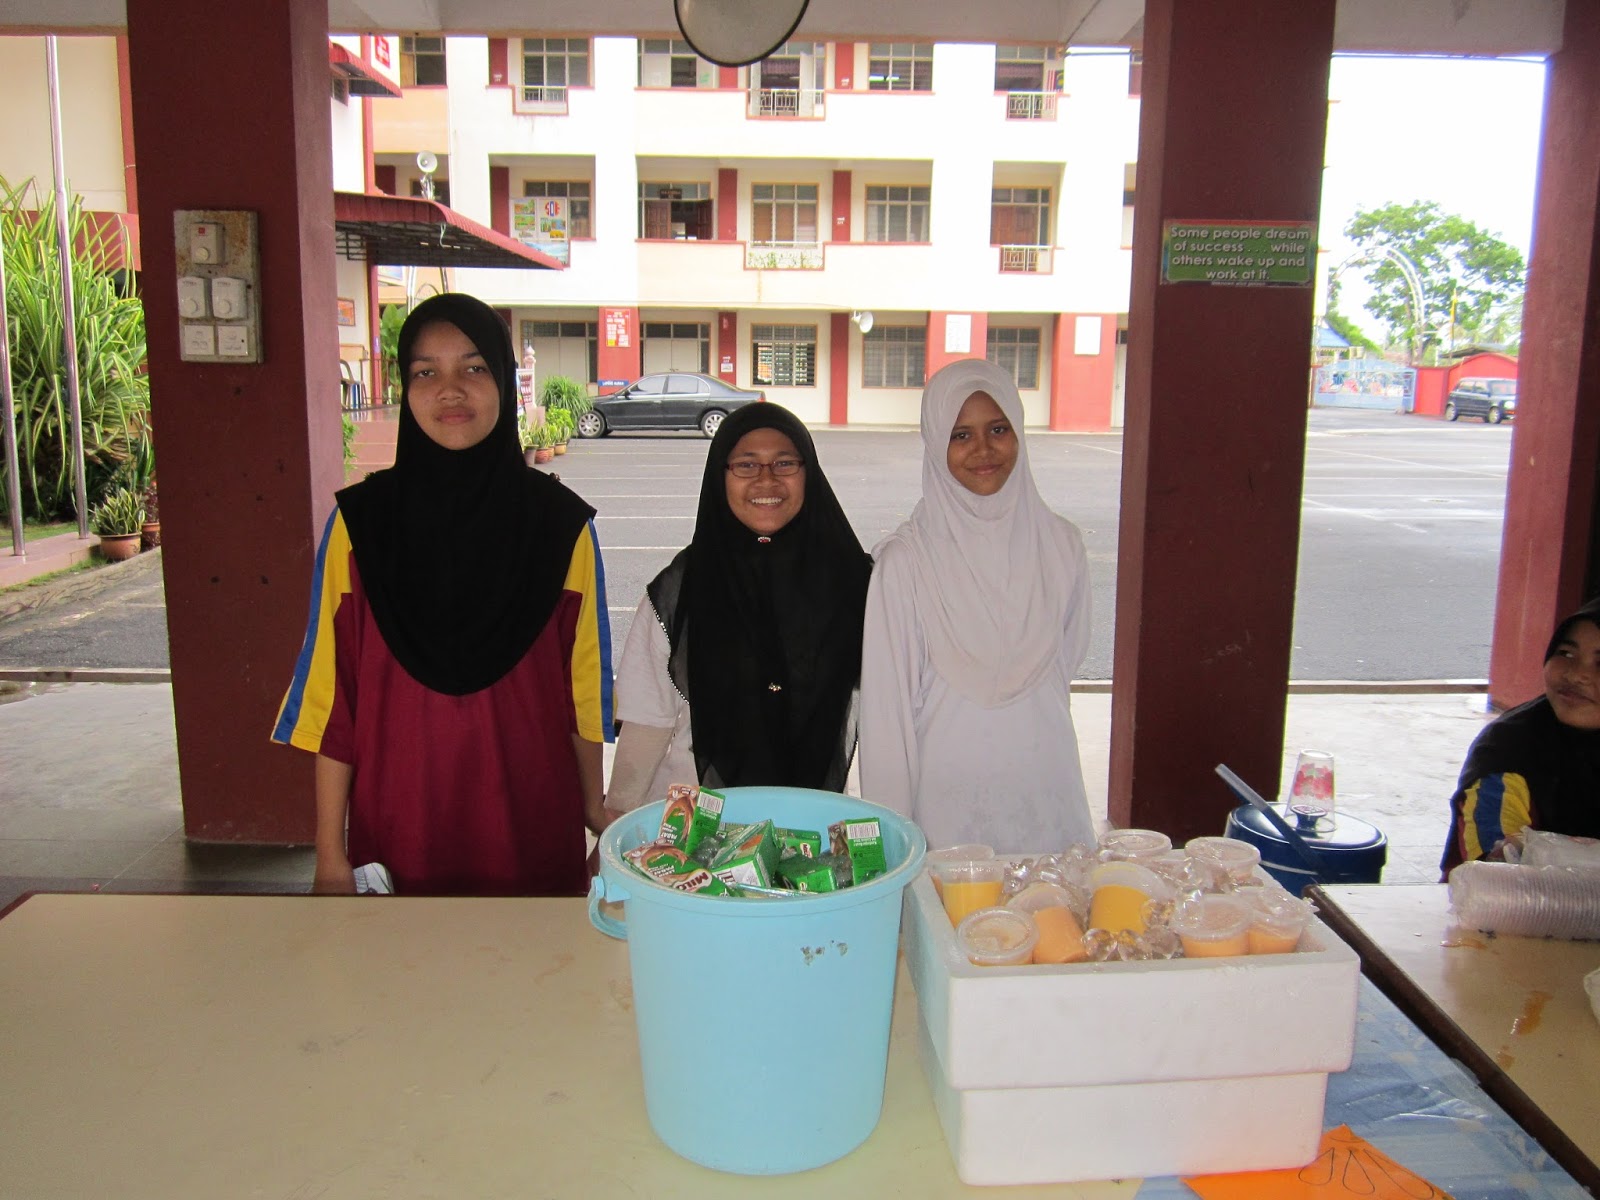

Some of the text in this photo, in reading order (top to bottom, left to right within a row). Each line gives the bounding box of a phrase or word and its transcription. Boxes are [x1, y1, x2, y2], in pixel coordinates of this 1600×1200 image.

[1171, 227, 1310, 240] Some people dream
[1174, 240, 1187, 251] of
[1190, 242, 1244, 252] success
[1271, 243, 1305, 253] while
[1172, 255, 1306, 268] others wake up and
[1206, 268, 1270, 280] work at it.
[676, 871, 709, 890] MILO
